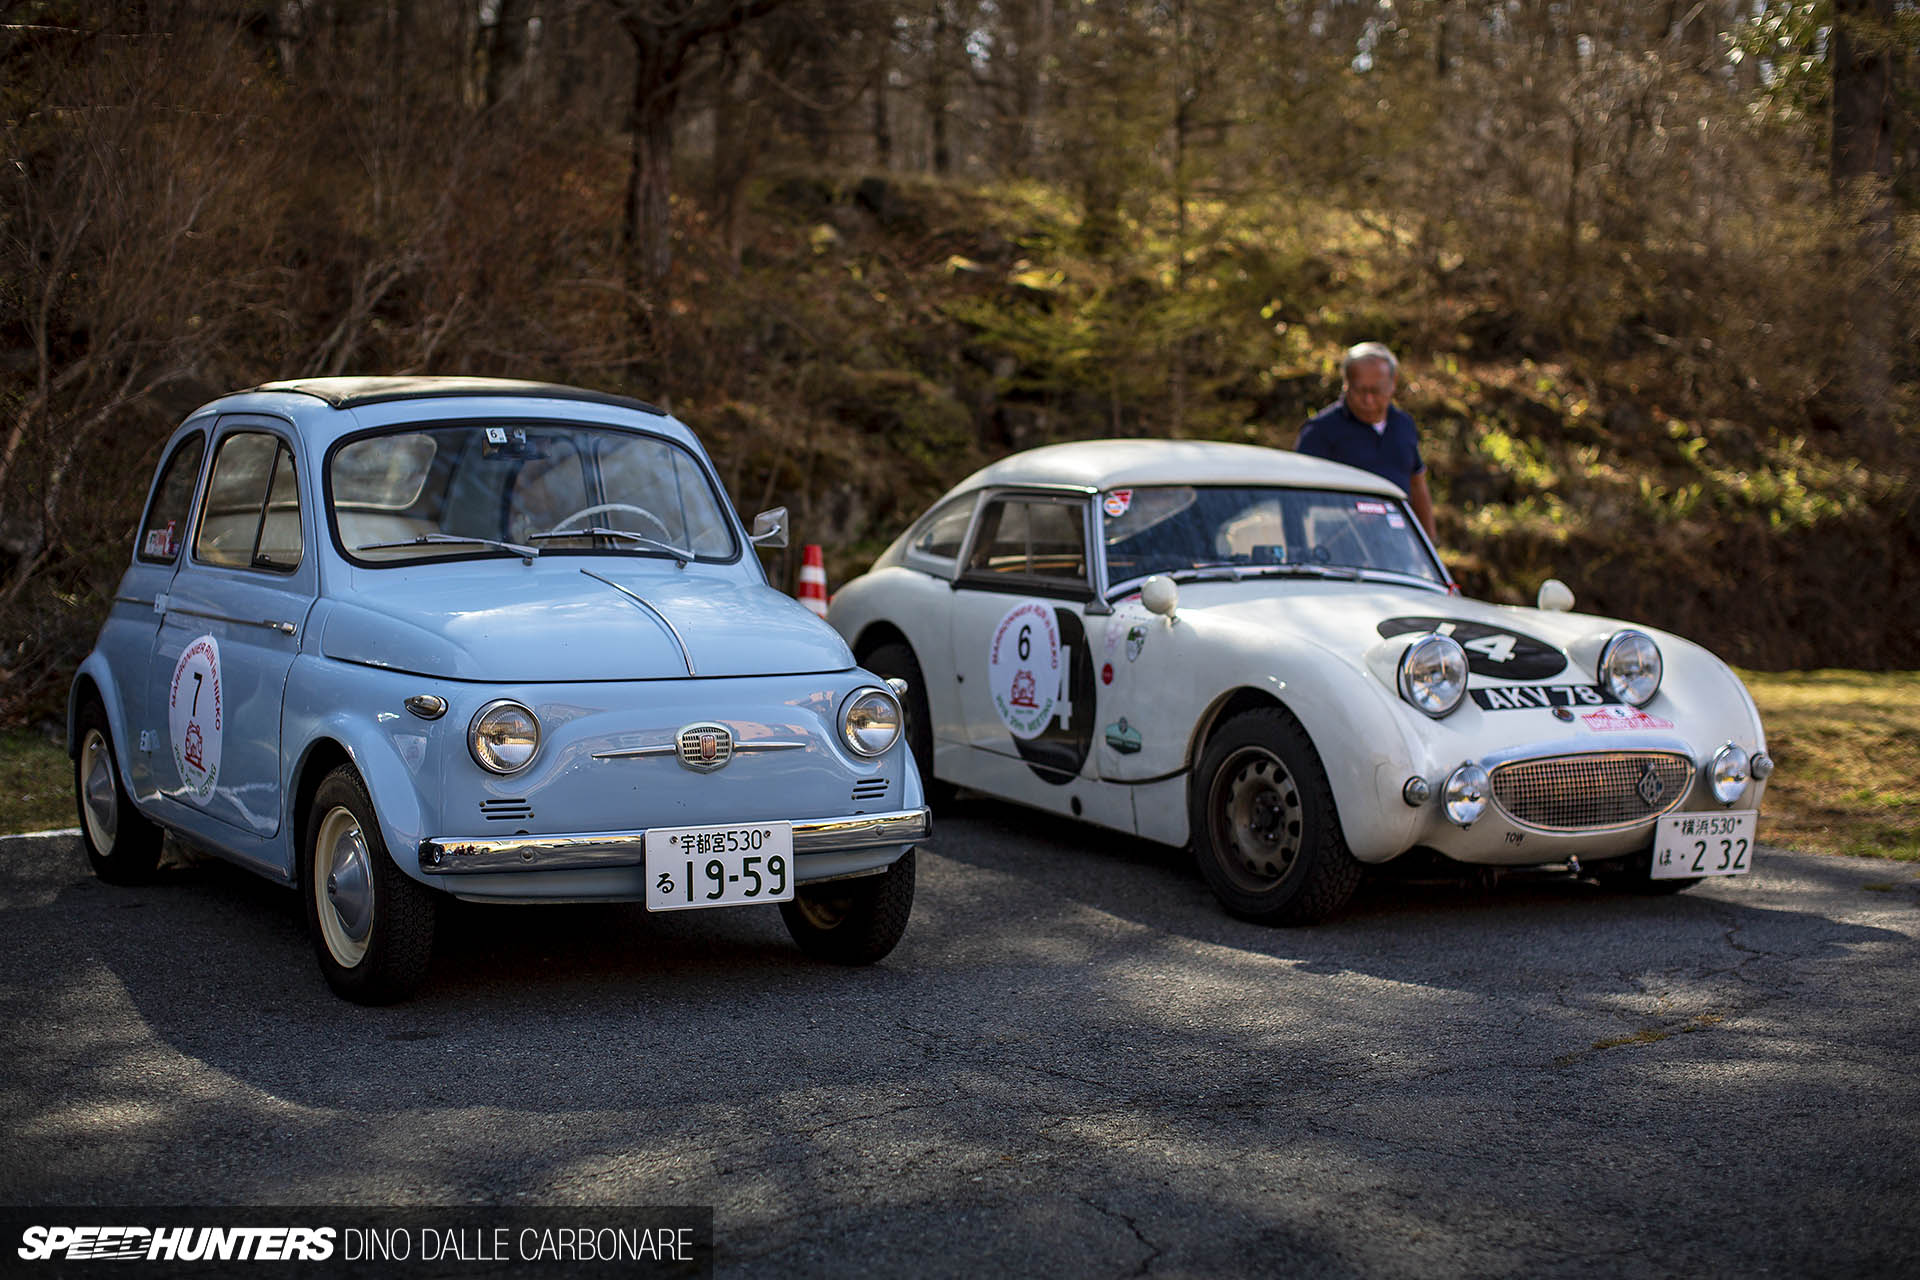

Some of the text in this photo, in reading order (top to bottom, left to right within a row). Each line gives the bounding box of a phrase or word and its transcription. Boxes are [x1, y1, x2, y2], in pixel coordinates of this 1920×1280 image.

[1018, 624, 1032, 662] 6
[193, 672, 203, 717] 7
[213, 679, 221, 731] NIKKO
[1484, 686, 1552, 709] AKV
[656, 855, 786, 902] る 19-59
